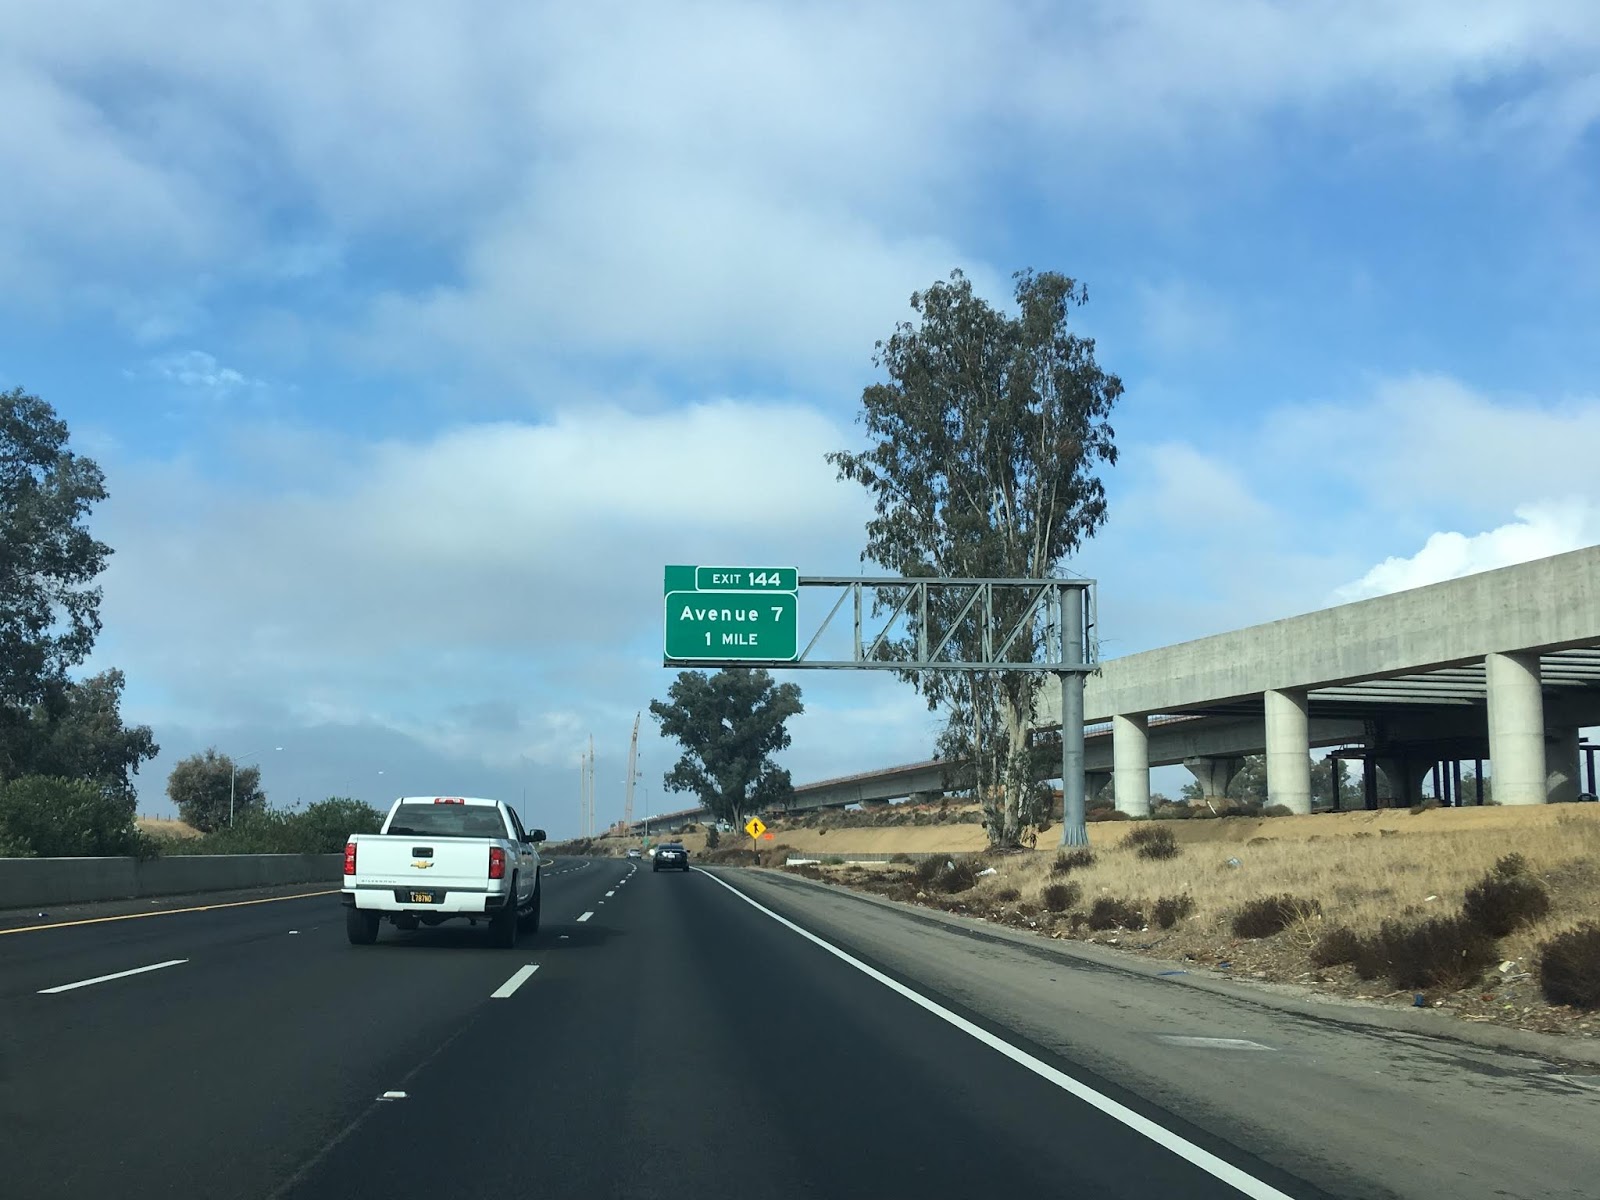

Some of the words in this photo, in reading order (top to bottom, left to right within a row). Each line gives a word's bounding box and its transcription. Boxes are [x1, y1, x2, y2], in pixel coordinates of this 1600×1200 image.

[712, 574, 741, 584] EXIT
[748, 572, 781, 587] 144
[680, 605, 759, 621] Avenue
[771, 606, 783, 622] 7
[705, 631, 711, 646] 1
[722, 633, 758, 645] MILE
